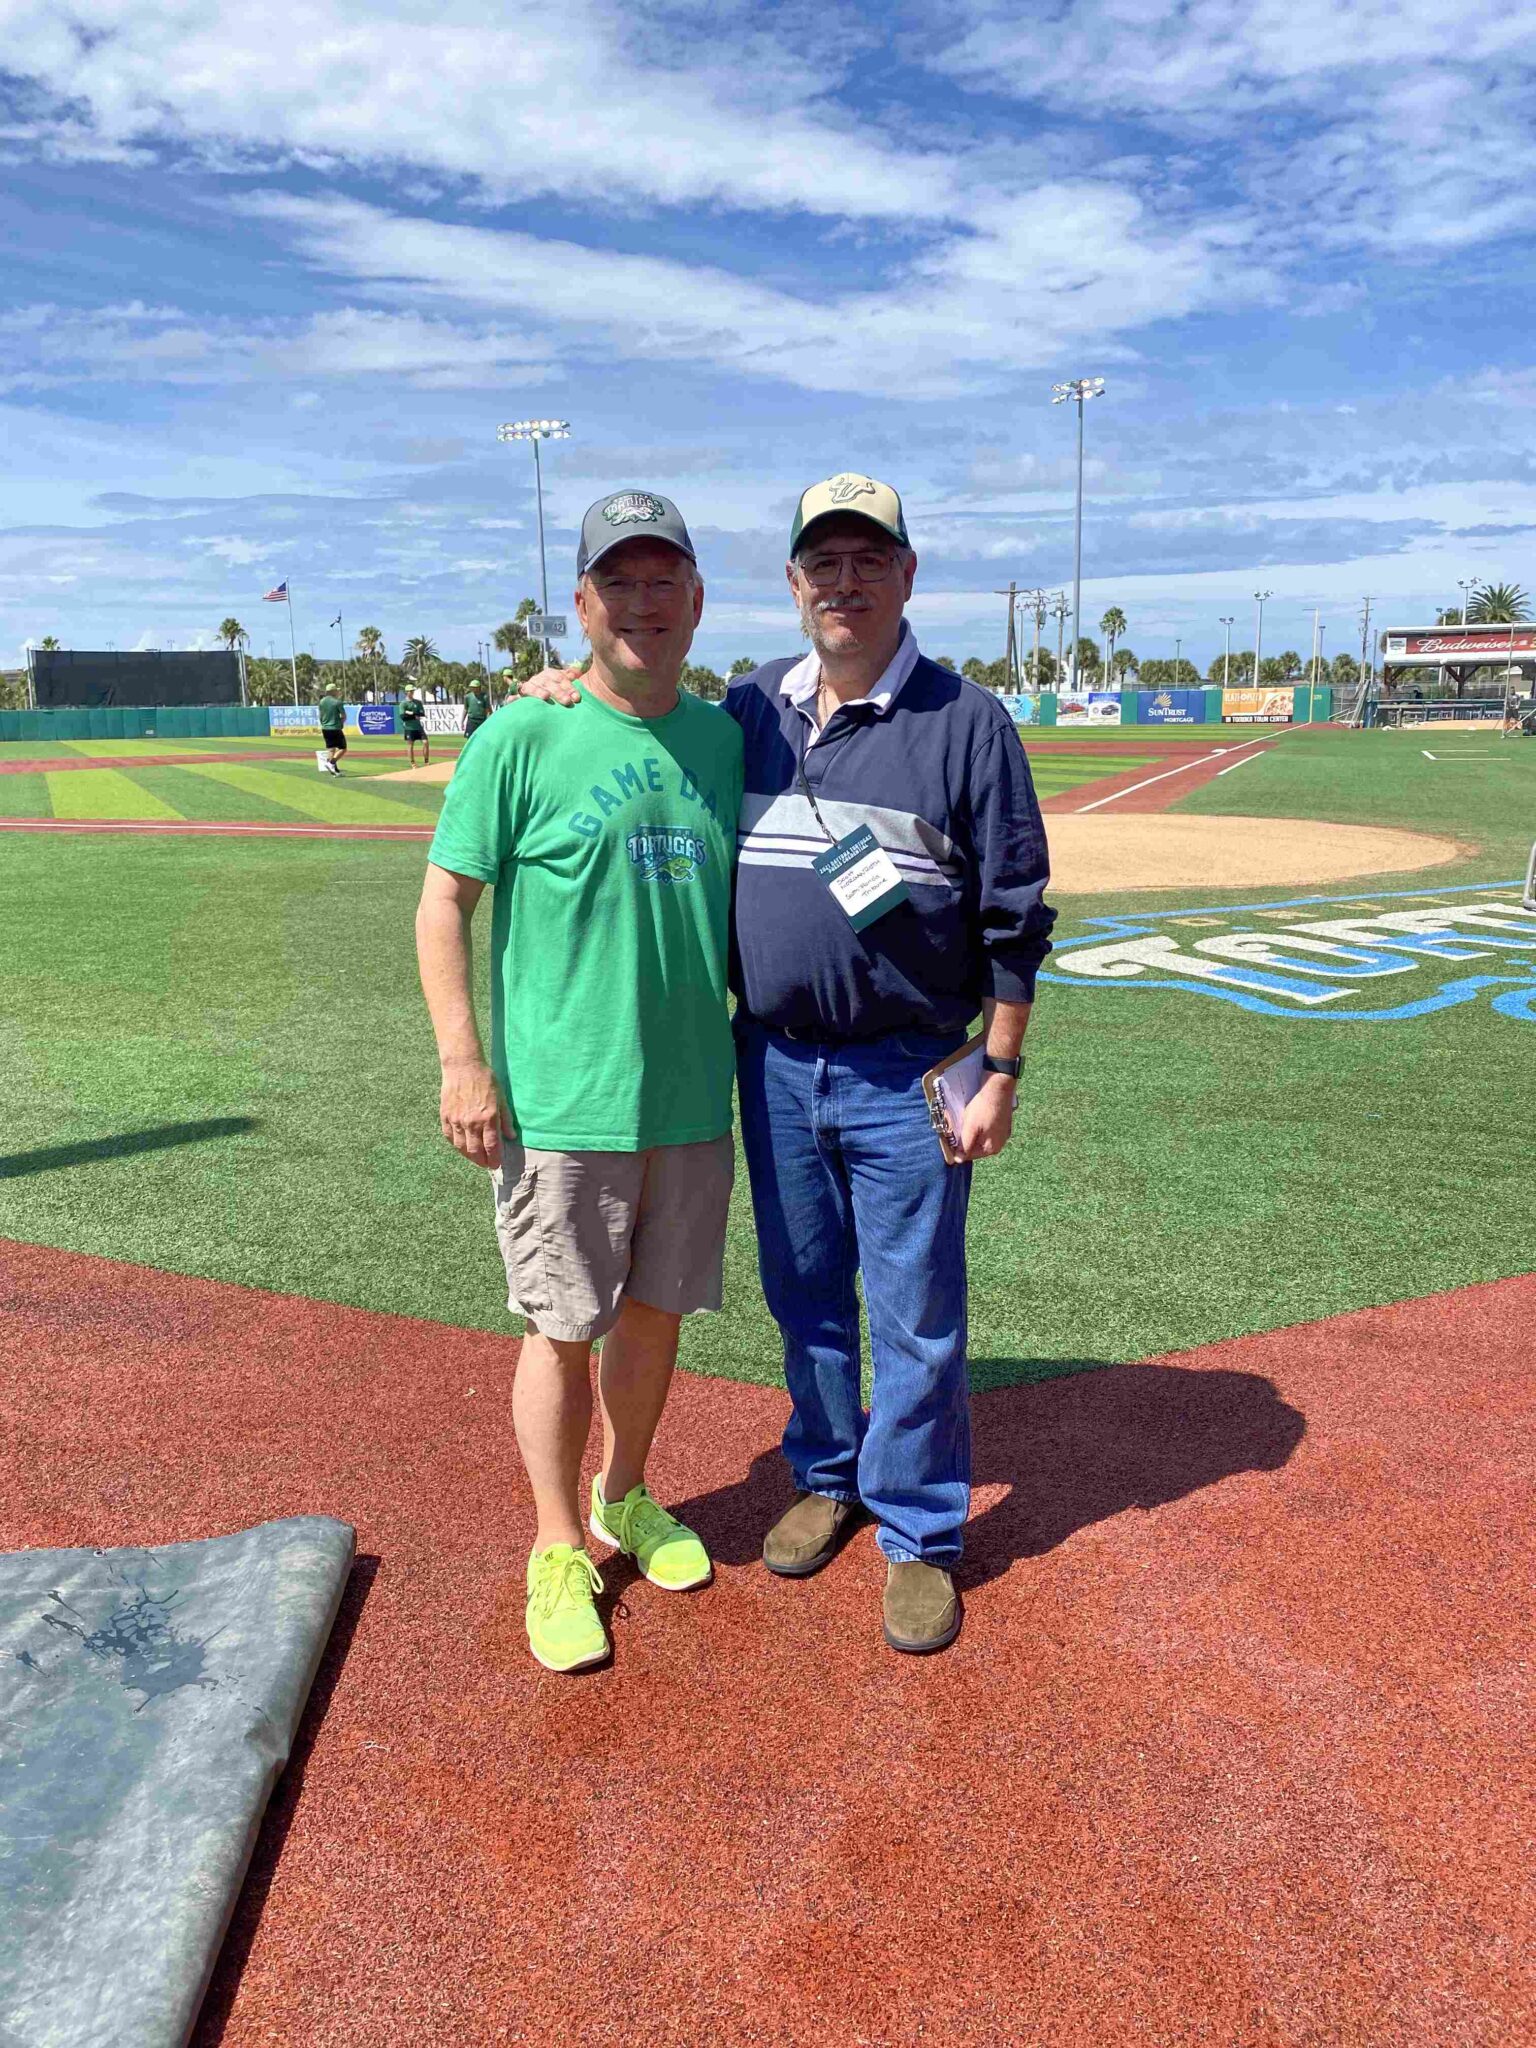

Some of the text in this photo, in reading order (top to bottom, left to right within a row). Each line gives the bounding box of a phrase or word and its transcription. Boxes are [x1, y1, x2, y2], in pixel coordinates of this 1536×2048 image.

[1416, 638, 1517, 653] Budweiser
[272, 708, 294, 717] SKIP
[296, 707, 314, 717] THE
[272, 717, 320, 726] BEFORE TH
[568, 758, 664, 839] GAME
[627, 833, 706, 865] TORTUGAS
